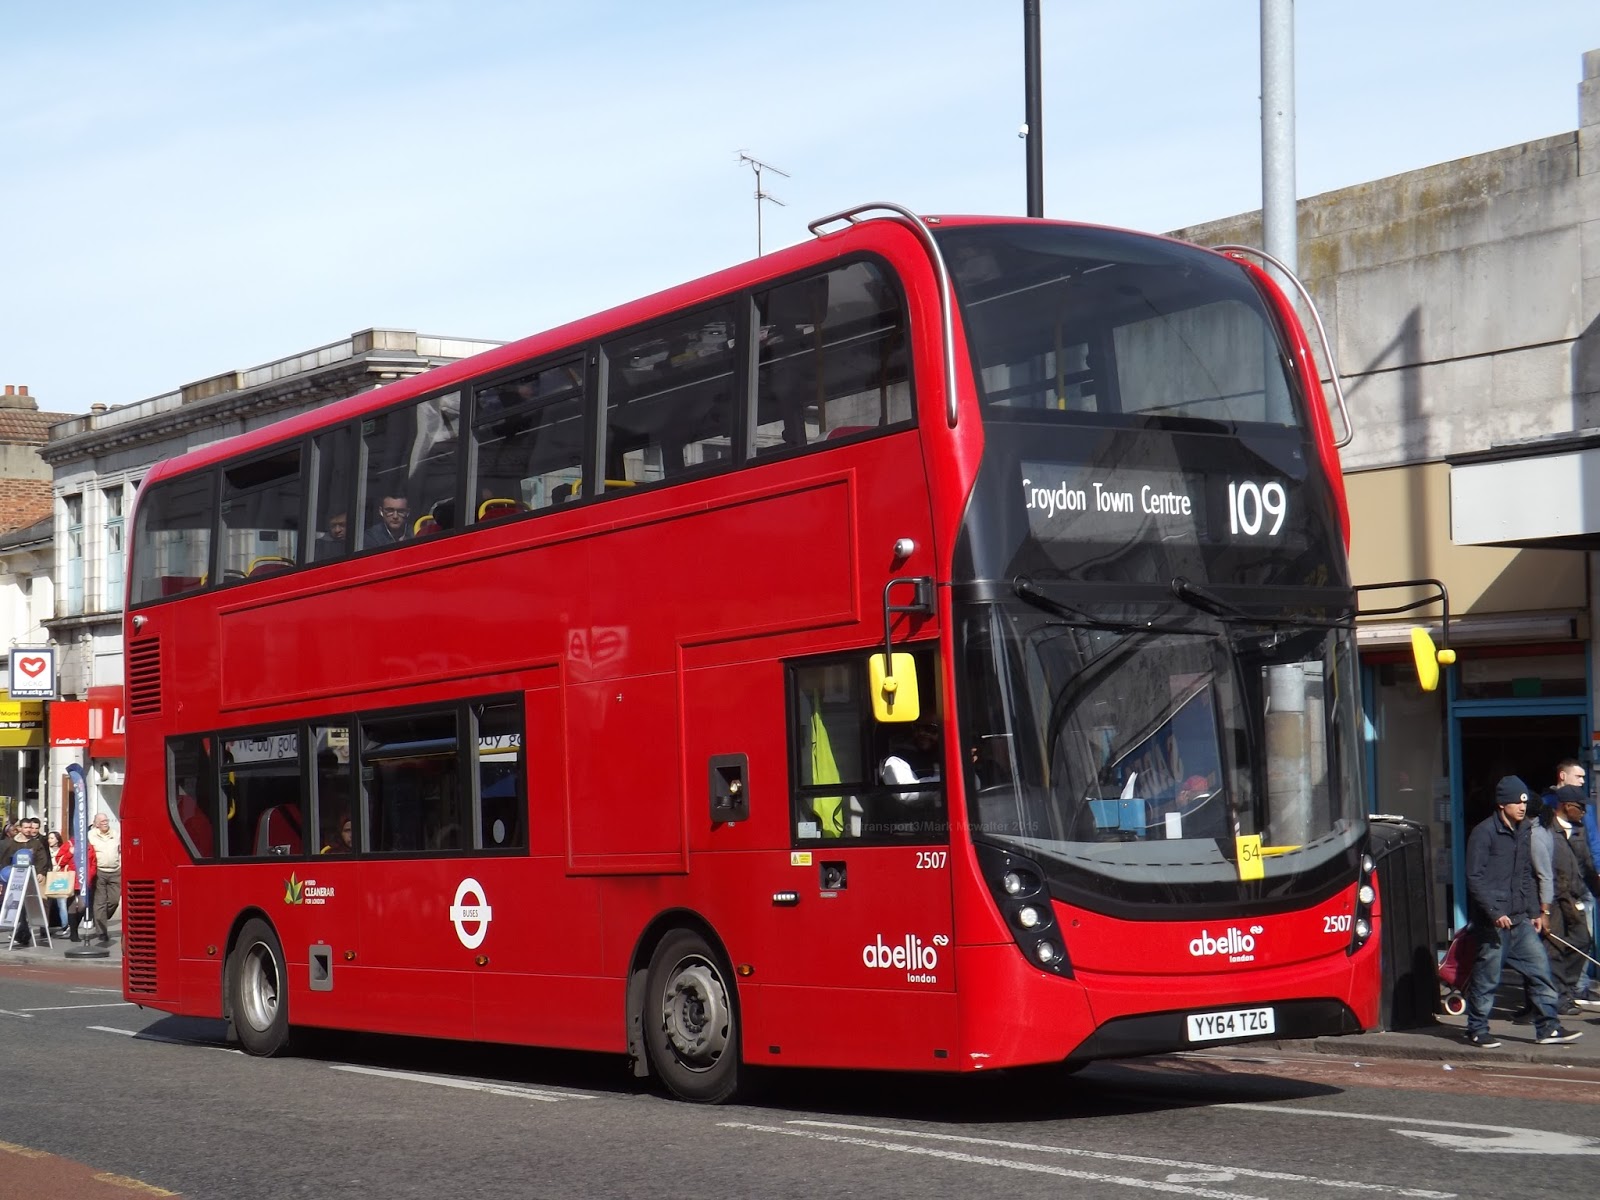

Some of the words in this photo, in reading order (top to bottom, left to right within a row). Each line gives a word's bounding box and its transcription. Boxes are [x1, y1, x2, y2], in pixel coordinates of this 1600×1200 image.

[1022, 479, 1087, 518] Croydon
[1092, 482, 1133, 512] Town
[1141, 485, 1192, 516] Centre
[1228, 480, 1287, 535] 109
[916, 851, 947, 869] 2507
[1242, 844, 1260, 861] 54
[463, 909, 479, 918] BUSES
[1323, 915, 1352, 933] 2507
[1189, 927, 1255, 956] abellio
[863, 933, 938, 970] abellio
[1229, 954, 1255, 963] london
[907, 973, 937, 983] london
[1195, 1014, 1235, 1036] YY64
[1239, 1011, 1268, 1031] TZG
